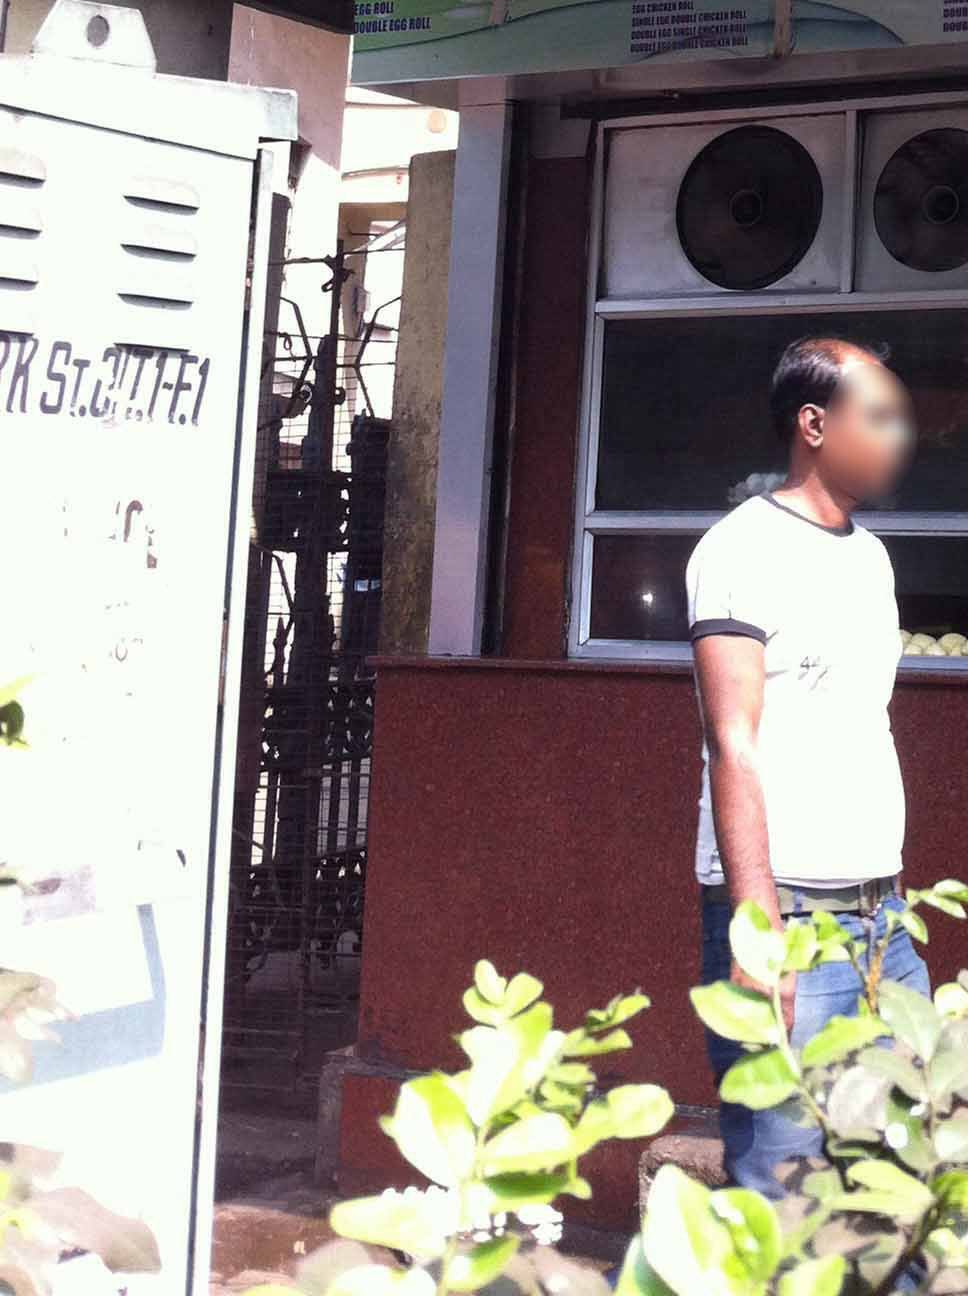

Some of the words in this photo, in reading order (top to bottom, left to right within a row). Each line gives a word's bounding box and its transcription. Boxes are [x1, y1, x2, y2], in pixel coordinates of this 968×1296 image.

[354, 2, 372, 16] EGG
[374, 1, 395, 15] ROLL
[354, 19, 388, 33] DOUBLE
[389, 18, 407, 31] EGG
[409, 17, 431, 30] ROLL
